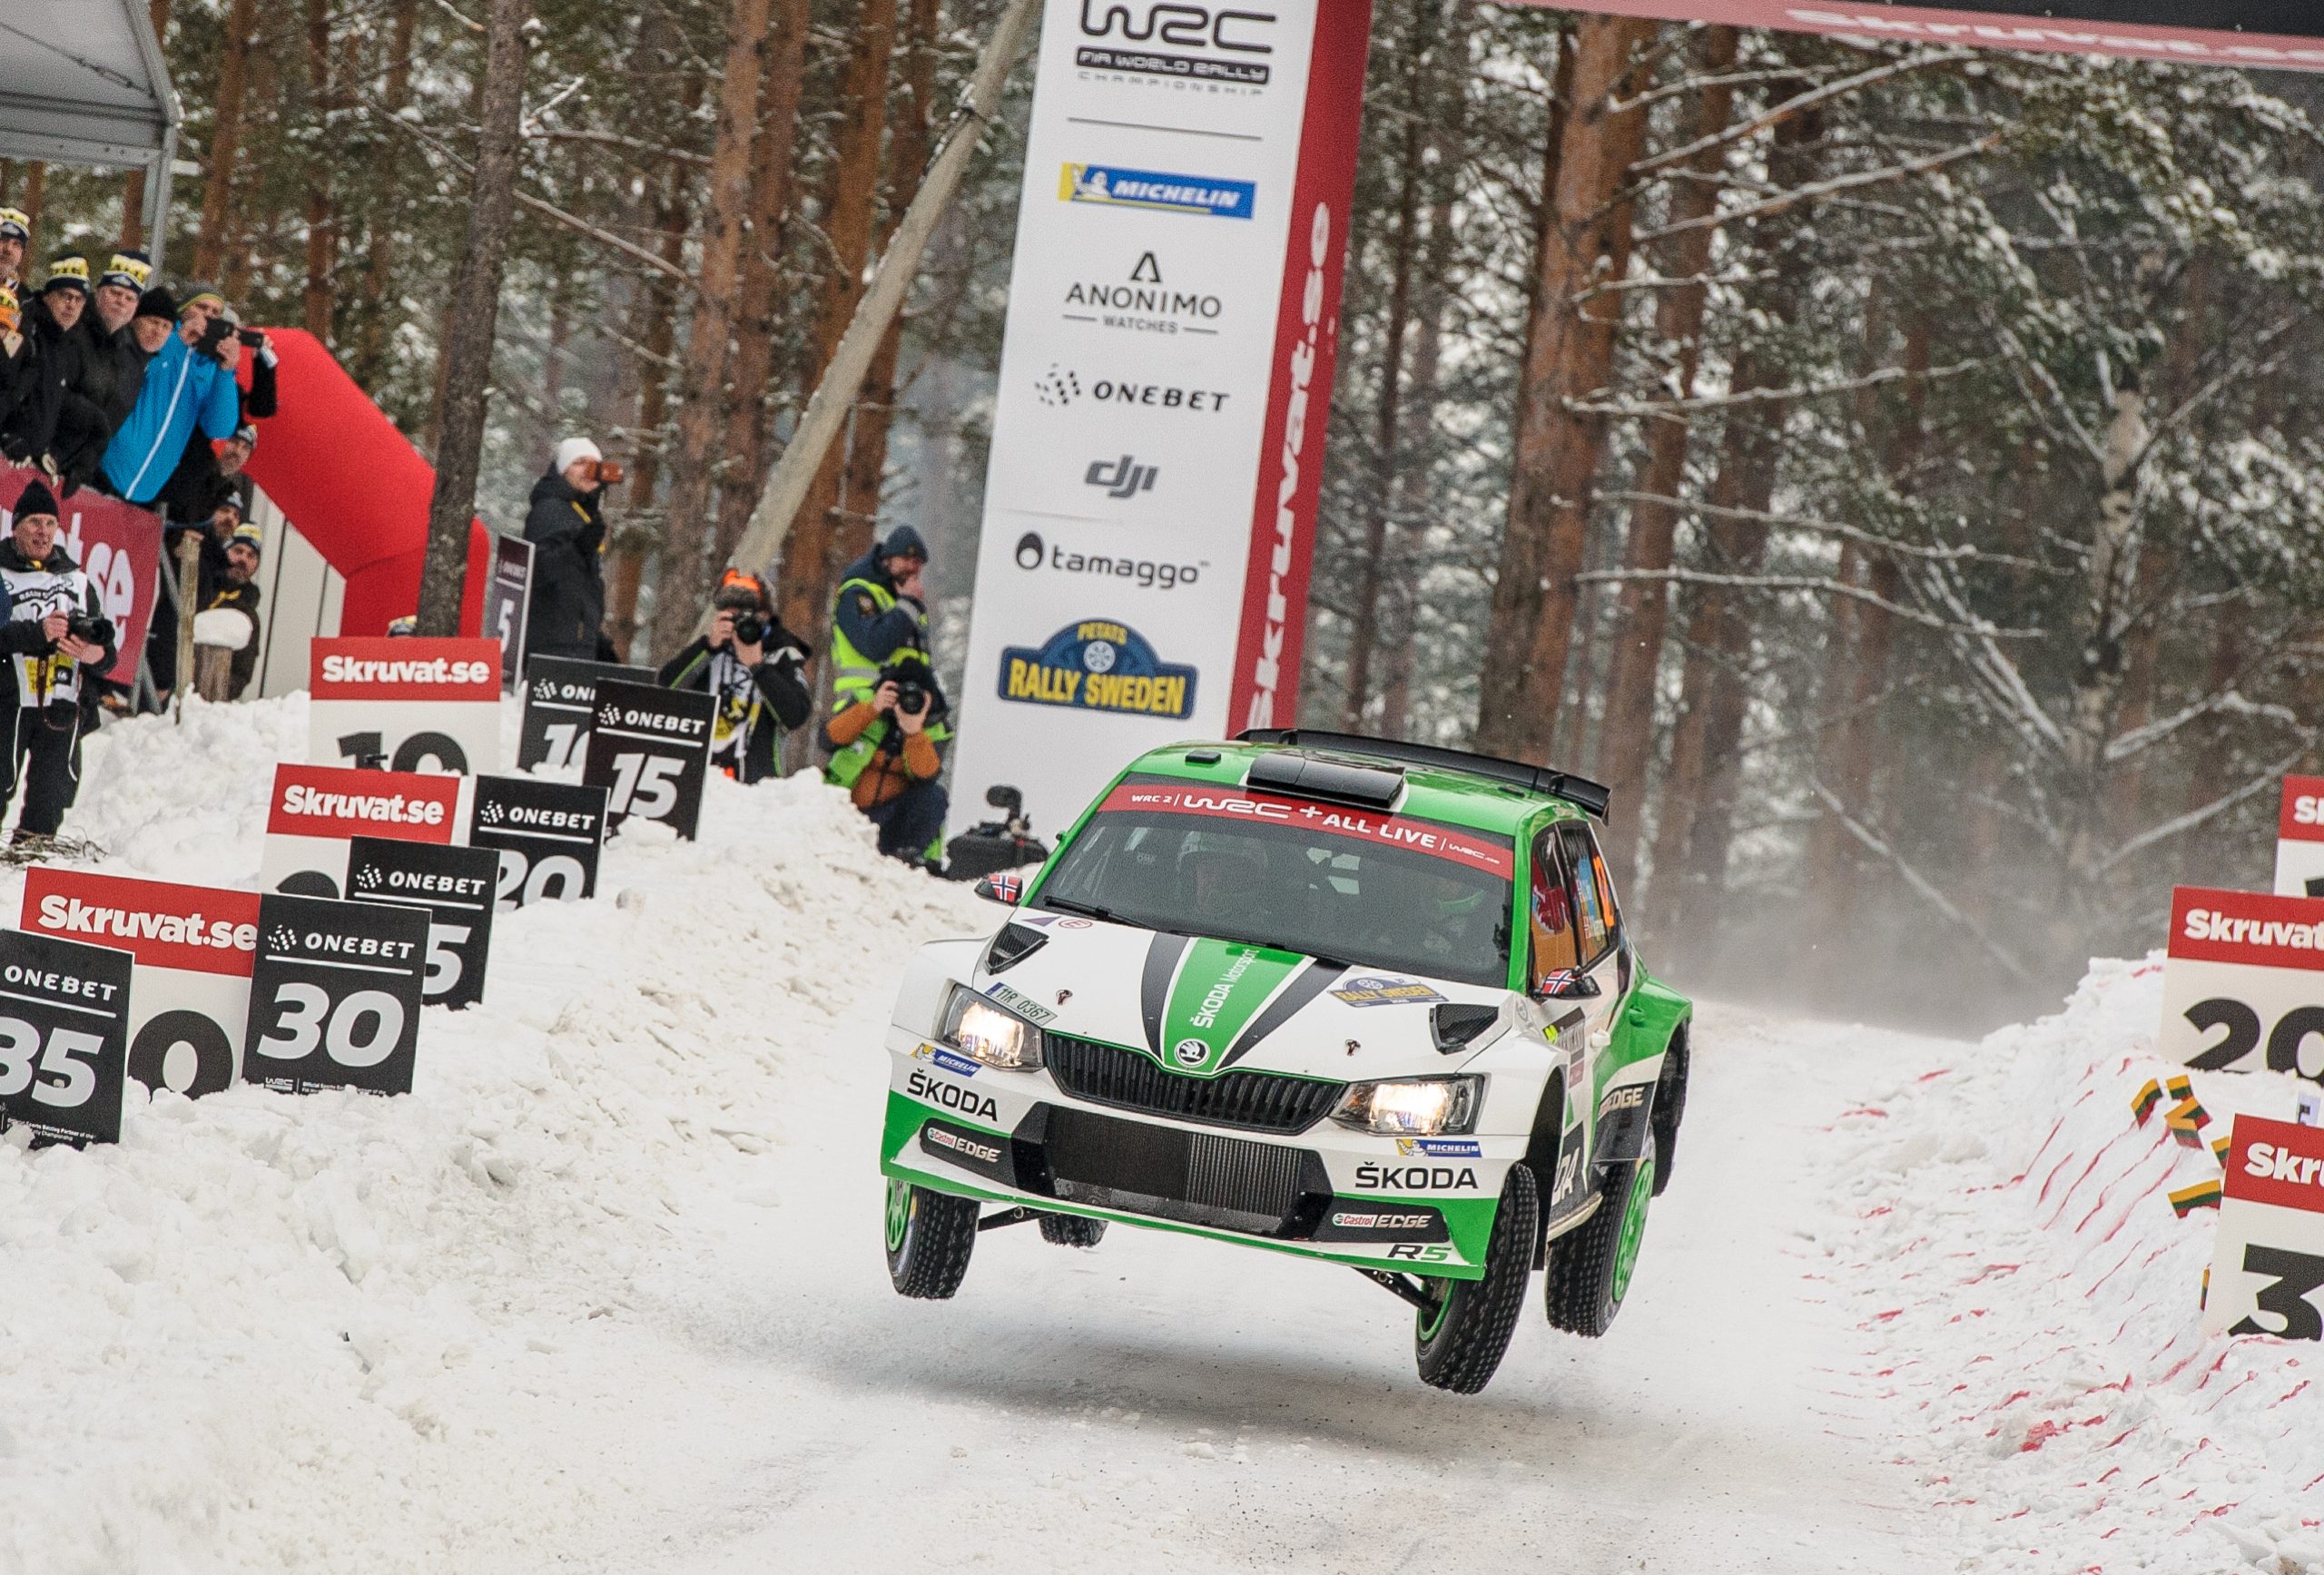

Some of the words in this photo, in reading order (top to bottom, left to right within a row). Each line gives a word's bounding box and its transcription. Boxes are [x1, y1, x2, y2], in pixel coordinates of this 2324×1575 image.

[1081, 0, 1276, 54] WRC
[1115, 54, 1190, 74] WORLD
[1193, 63, 1266, 81] RALLY
[1078, 71, 1264, 95] CHAMPIONSHIP
[1111, 180, 1241, 209] MICHELIN
[1065, 283, 1222, 319] ANONIMO
[1103, 315, 1178, 334] WATCHES
[1094, 380, 1229, 411] ONEBET
[322, 655, 490, 684] Skruvat.se
[1008, 658, 1082, 704] RALLY
[1084, 672, 1186, 714] SWEDEN
[625, 710, 706, 735] ONEBET
[608, 753, 685, 819] 15
[282, 785, 445, 825] Skruvat.se
[508, 807, 596, 831] ONEBET
[1131, 794, 1160, 803] WRC
[1163, 795, 1172, 803] 2
[1184, 794, 1293, 819] WRC
[1323, 814, 1372, 833] ALL
[1379, 824, 1437, 849] LIVE
[389, 871, 487, 895] ONEBET
[38, 894, 257, 951] Skruvat.se
[305, 932, 415, 960] ONEBET
[5, 965, 117, 1001] ONEBET
[1189, 984, 1235, 1029] ŠKODA
[1219, 949, 1260, 983] Motorsport
[996, 988, 1019, 1003] 11R
[1016, 1000, 1051, 1020] 0367
[256, 981, 405, 1068] 30
[938, 1054, 979, 1072] MICHELIN
[908, 1068, 998, 1121] ŠKODA
[955, 1137, 1001, 1163] EDGE
[1426, 1144, 1480, 1152] MICHELIN
[1355, 1161, 1479, 1189] ŠKODA
[2244, 1142, 2324, 1187] Skr
[1344, 1216, 1374, 1226] Castrol
[1374, 1215, 1433, 1228] EDGE
[1387, 1245, 1452, 1261] R5
